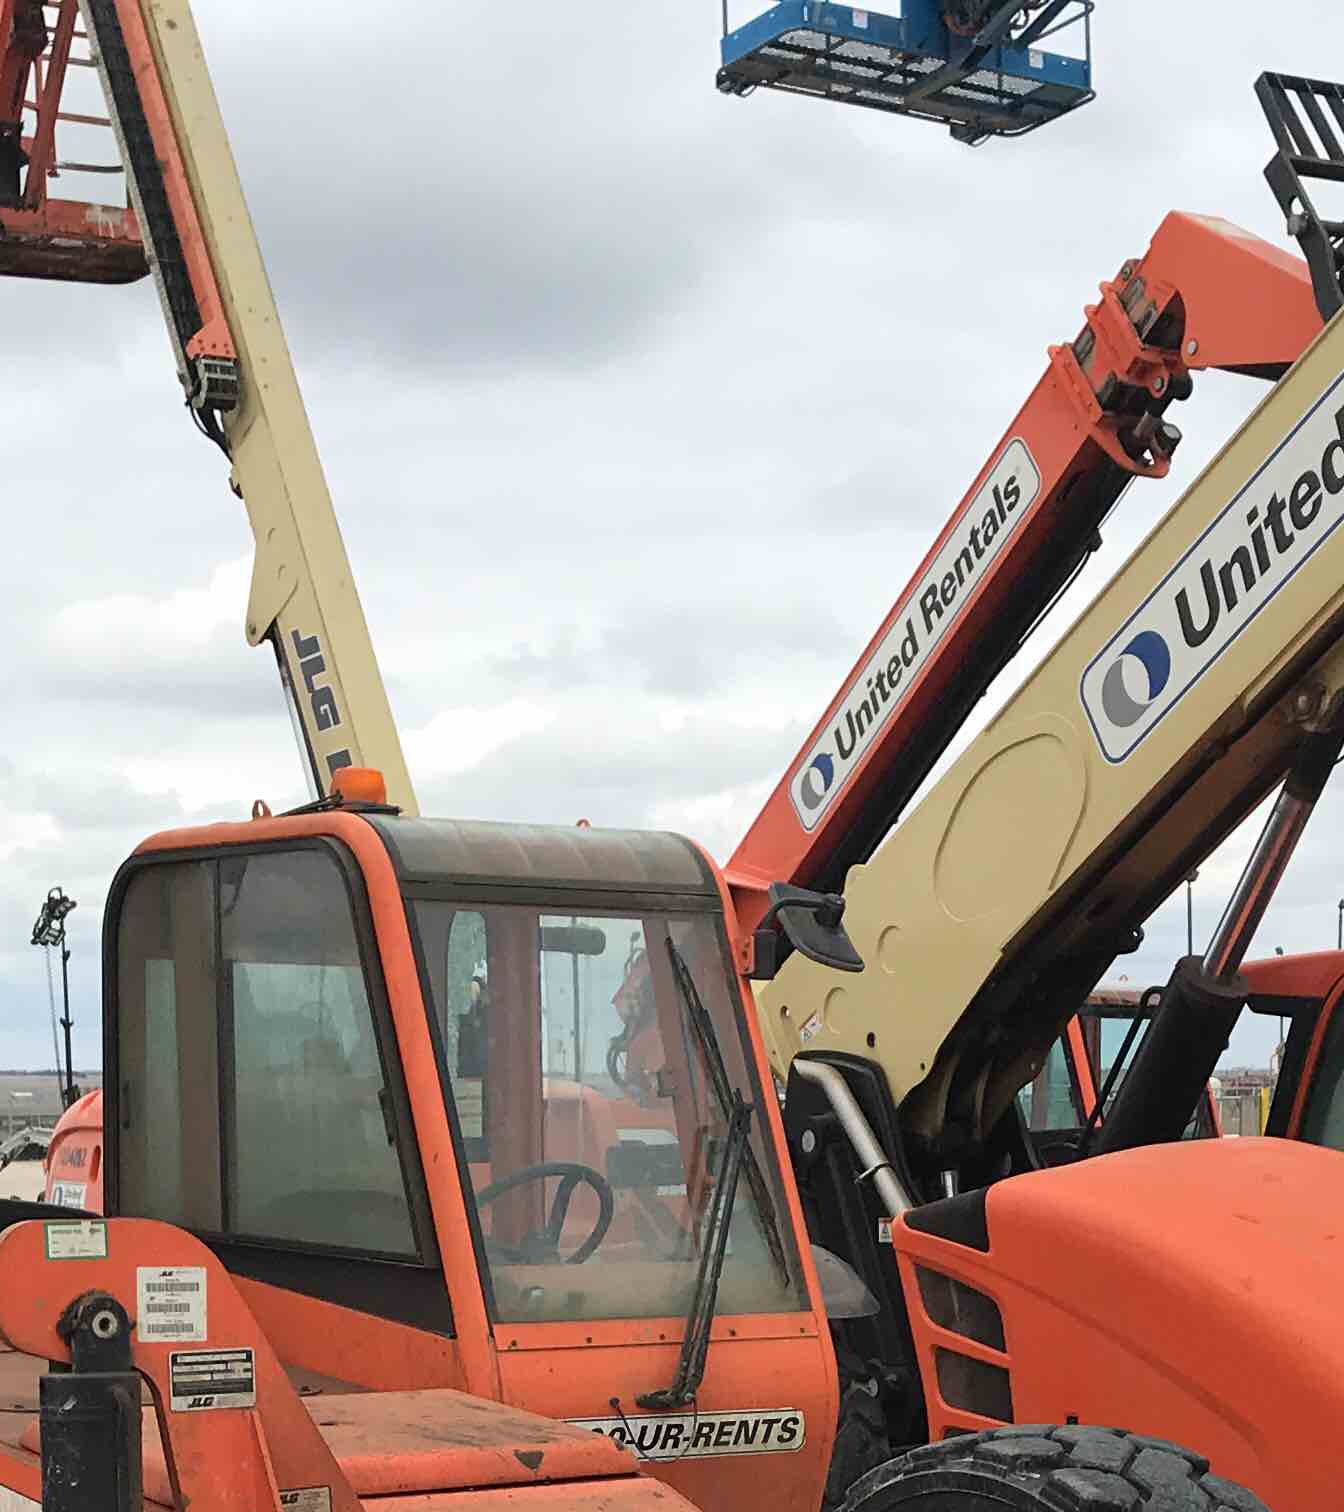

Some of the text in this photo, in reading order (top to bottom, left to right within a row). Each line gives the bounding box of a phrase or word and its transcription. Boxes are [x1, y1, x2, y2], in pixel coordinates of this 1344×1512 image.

[833, 474, 1021, 760] United Rentals
[291, 629, 342, 731] JLG
[187, 1396, 216, 1408] JLG
[592, 1416, 799, 1450] 0-UR-RENTS
